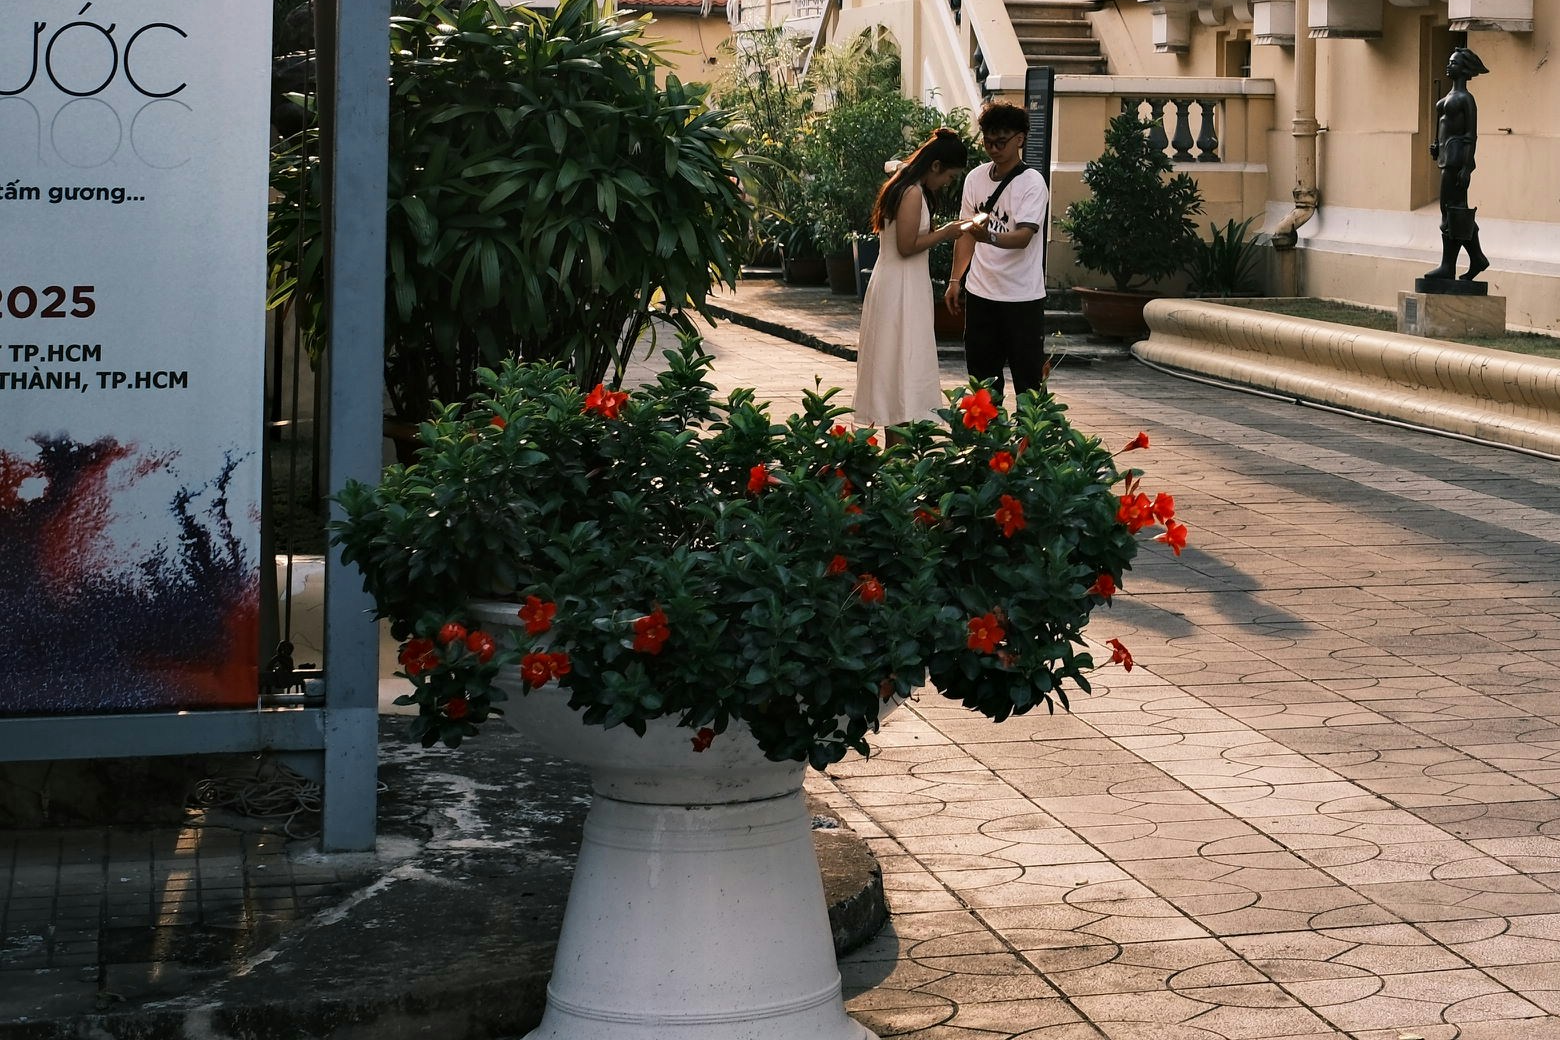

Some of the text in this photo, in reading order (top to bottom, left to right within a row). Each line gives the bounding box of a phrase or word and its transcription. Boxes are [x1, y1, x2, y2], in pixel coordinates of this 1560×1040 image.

[0, 178, 145, 204] ấm gương...
[0, 285, 96, 319] 025
[8, 344, 102, 362] TP.HCM
[0, 365, 189, 394] THÀNH, TP.HCM
